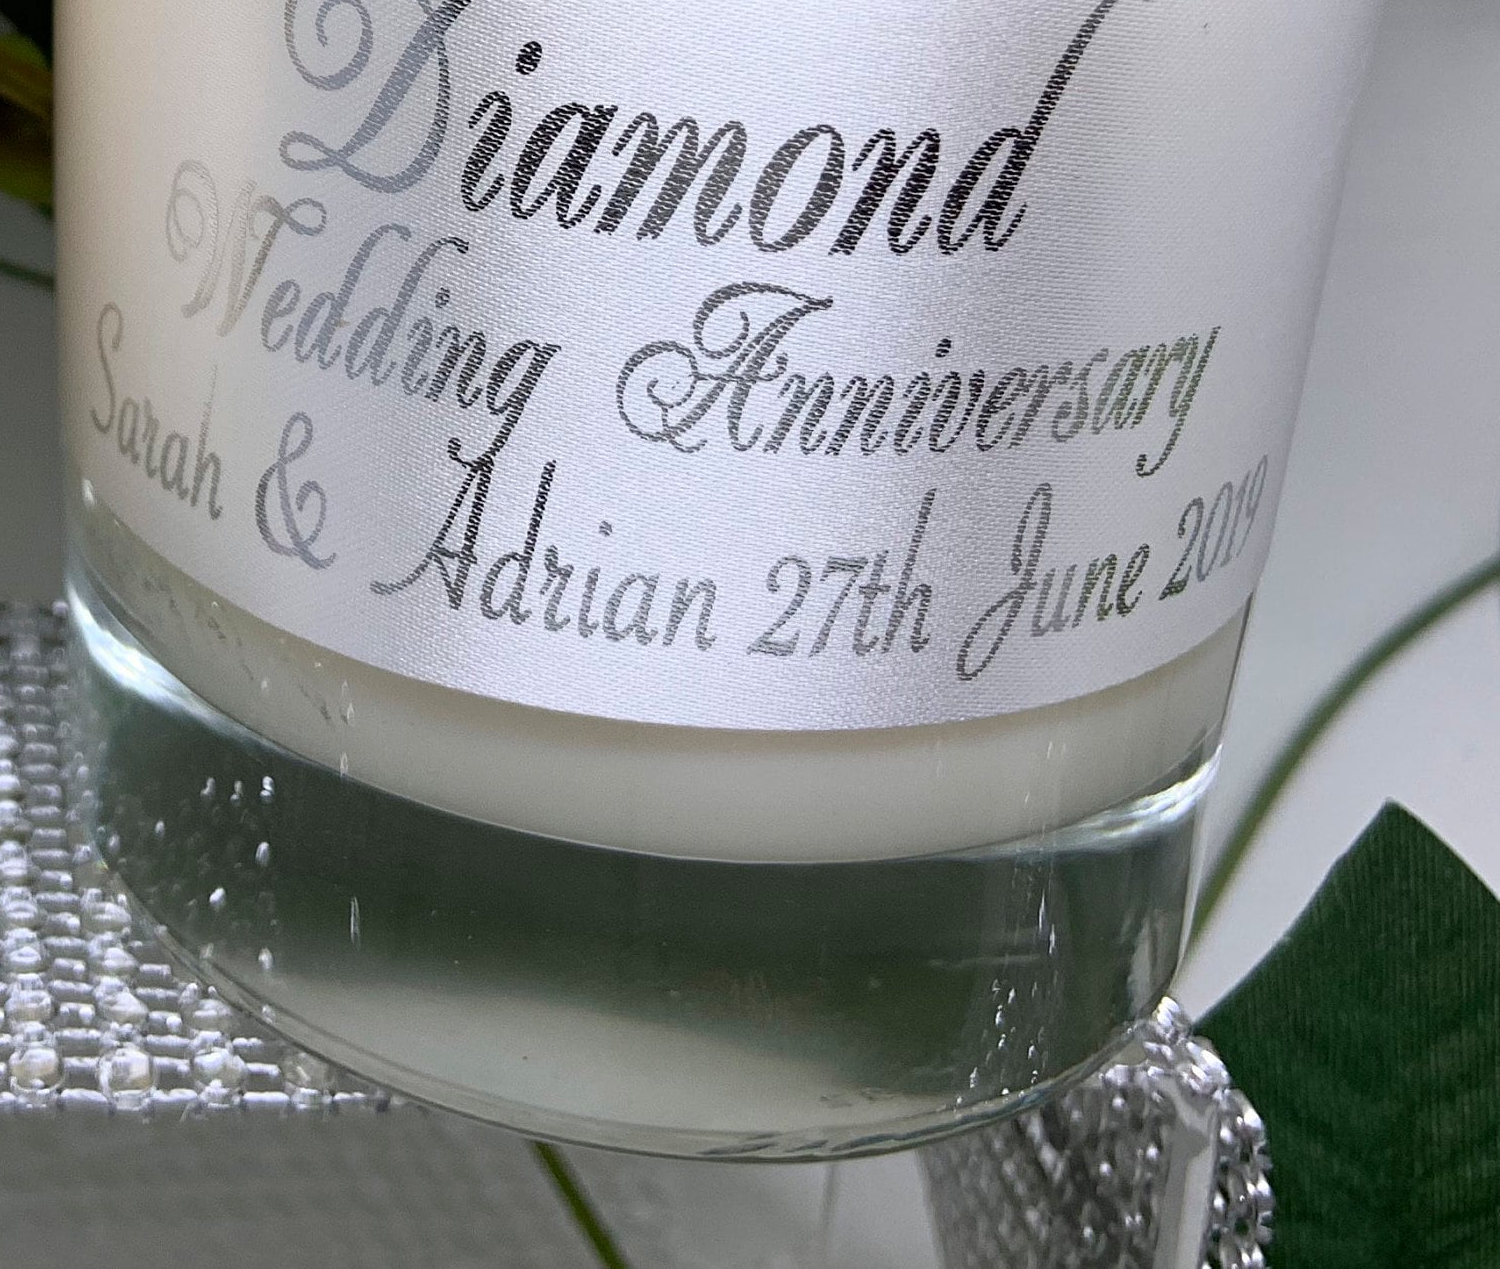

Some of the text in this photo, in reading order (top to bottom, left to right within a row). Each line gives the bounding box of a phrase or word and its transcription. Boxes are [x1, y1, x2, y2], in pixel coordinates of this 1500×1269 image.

[91, 301, 1271, 682] Sarah & Adrian 27th June 2019
[166, 158, 1222, 478] Wedding Anniversary
